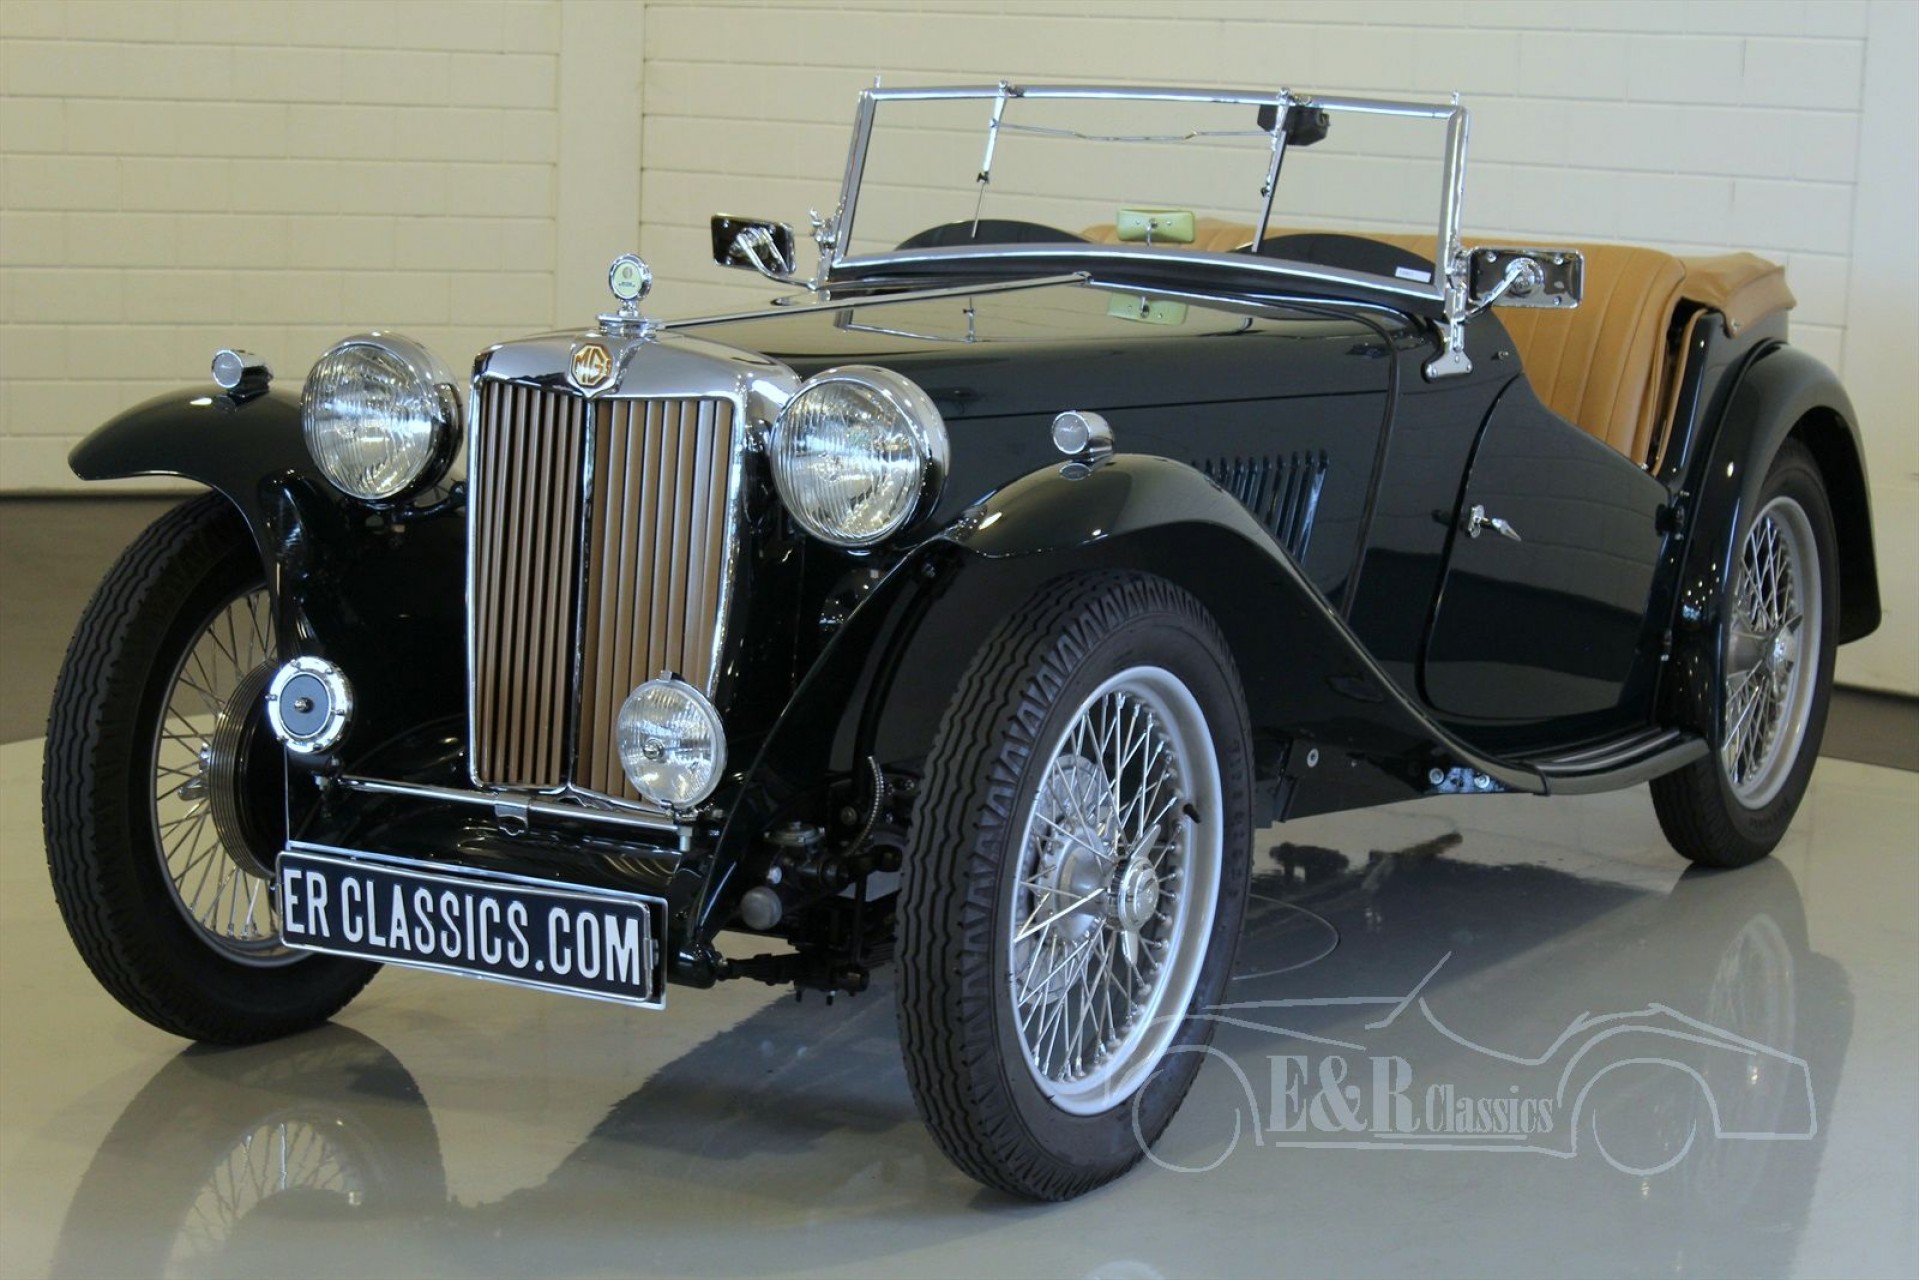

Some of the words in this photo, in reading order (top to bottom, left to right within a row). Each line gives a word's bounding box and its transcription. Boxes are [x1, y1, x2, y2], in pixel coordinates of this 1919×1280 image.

[574, 346, 610, 385] MG
[283, 867, 330, 938] ER
[341, 876, 640, 986] CLASSICS.COM
